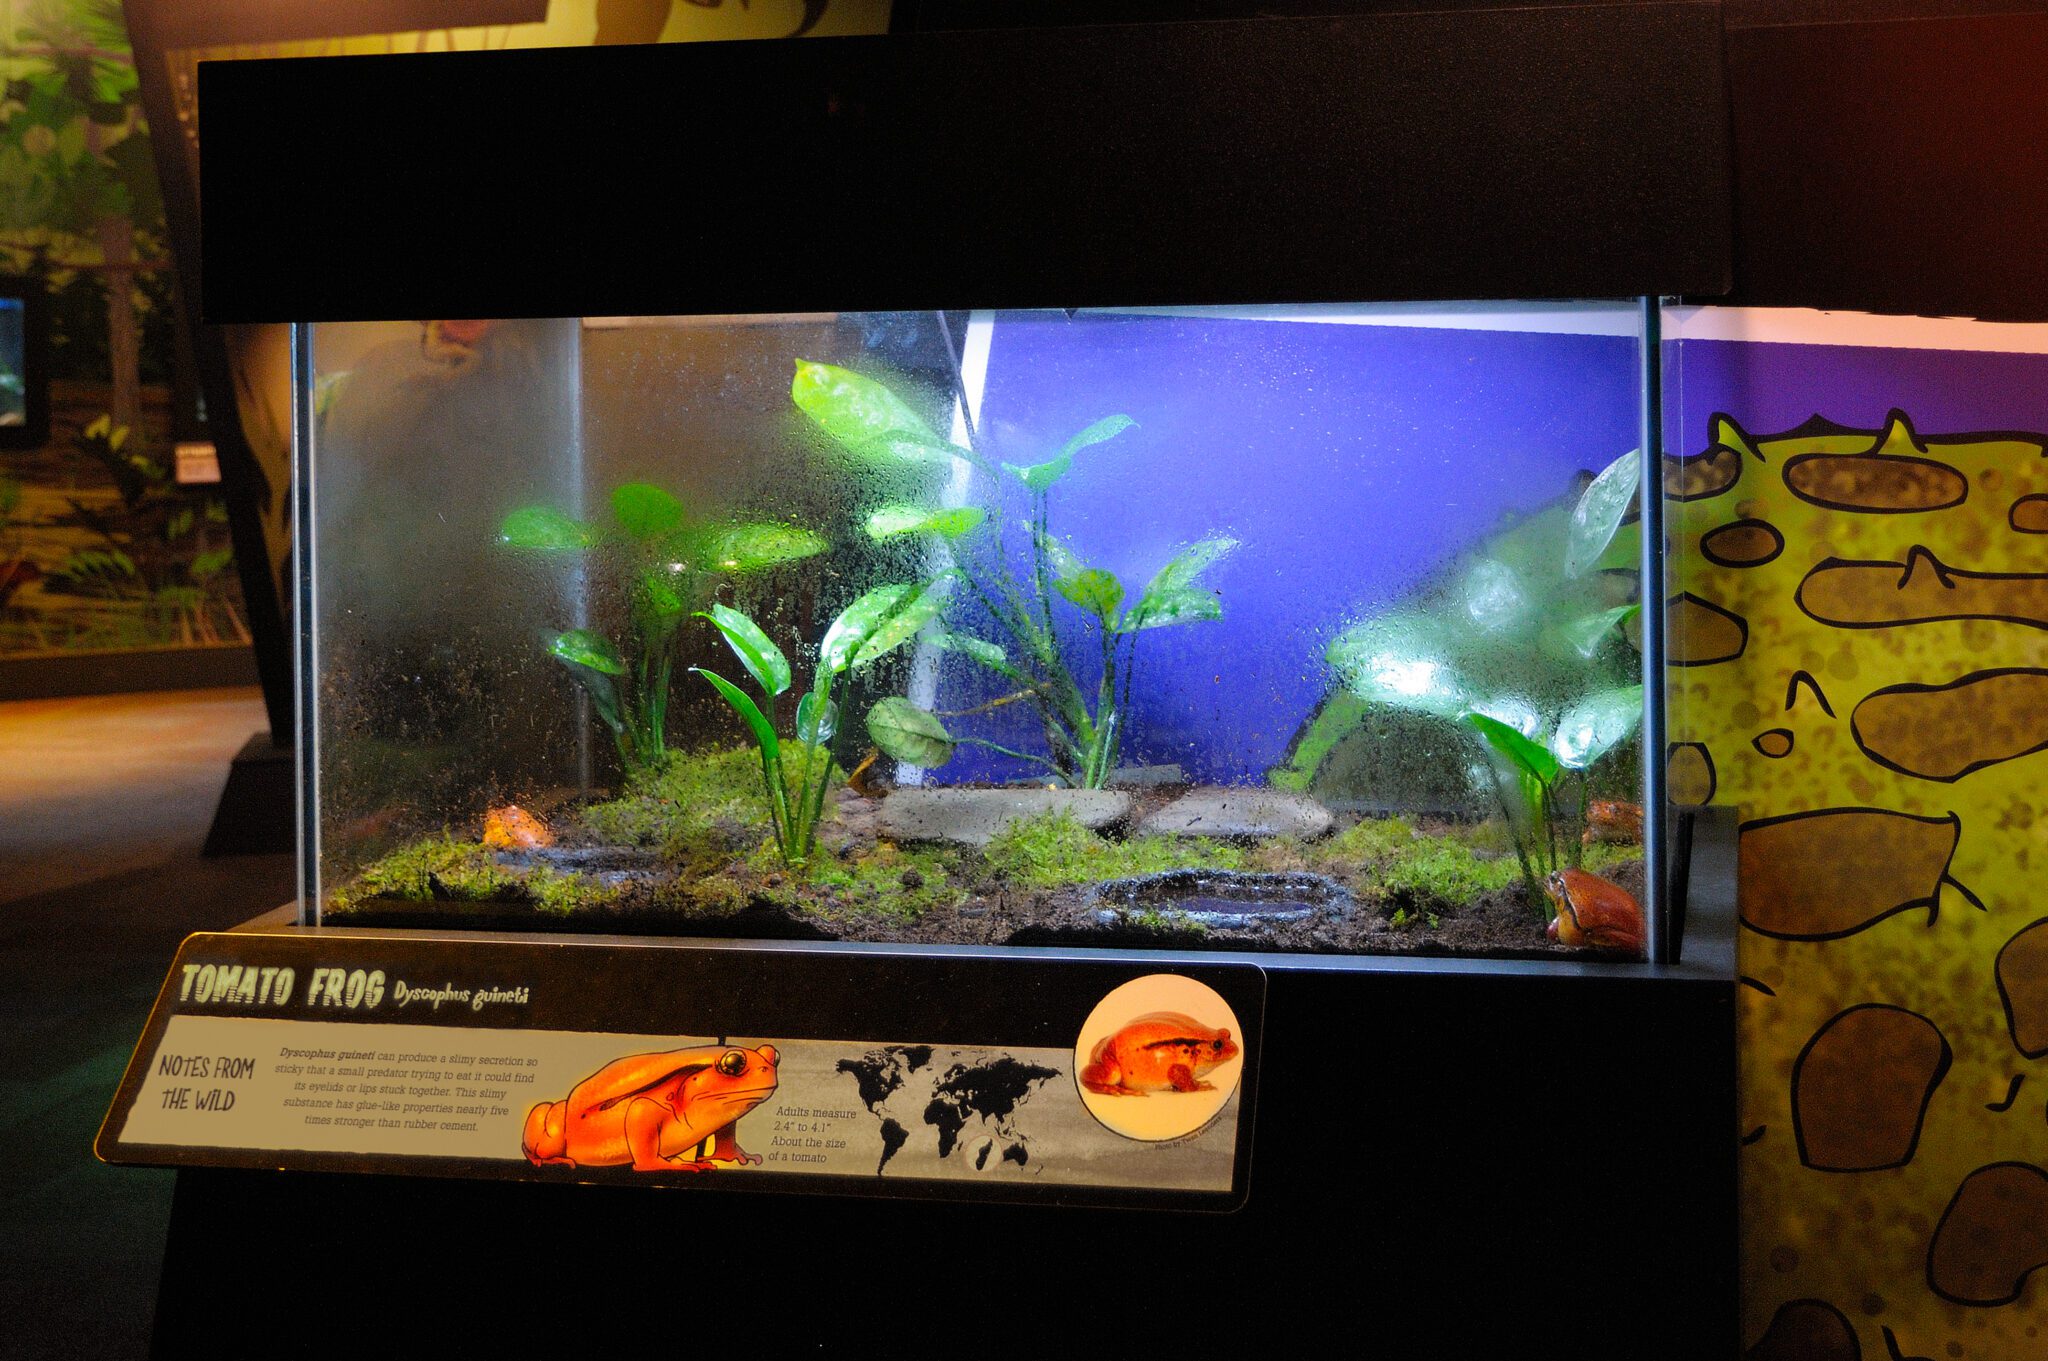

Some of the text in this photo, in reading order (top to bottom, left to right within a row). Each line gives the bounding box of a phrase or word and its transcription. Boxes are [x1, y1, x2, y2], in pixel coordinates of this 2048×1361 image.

[180, 963, 386, 1009] TOMATO FROG
[394, 979, 530, 1011] Dyscophus guineti
[280, 1047, 336, 1059] Dyscophus
[338, 1050, 376, 1061] guineti
[378, 1053, 394, 1061] can
[398, 1053, 437, 1063] produce
[449, 1054, 476, 1066] slimy
[479, 1056, 523, 1066] secretion
[526, 1058, 538, 1066] so
[159, 1055, 255, 1079] NOTES FROM
[275, 1064, 535, 1083] sticky that a small predator trying to eat it could find
[162, 1088, 235, 1111] THE WILD
[294, 1081, 506, 1101] its eyelids or lips stuck together. This slimy
[283, 1097, 509, 1117] substance has glue-like properties nearly five
[776, 1106, 856, 1119] Adults measure
[305, 1115, 478, 1131] times stronger than rubber cement.
[798, 1123, 807, 1132] to
[771, 1136, 846, 1148] About the size
[769, 1151, 827, 1162] of a tomato
